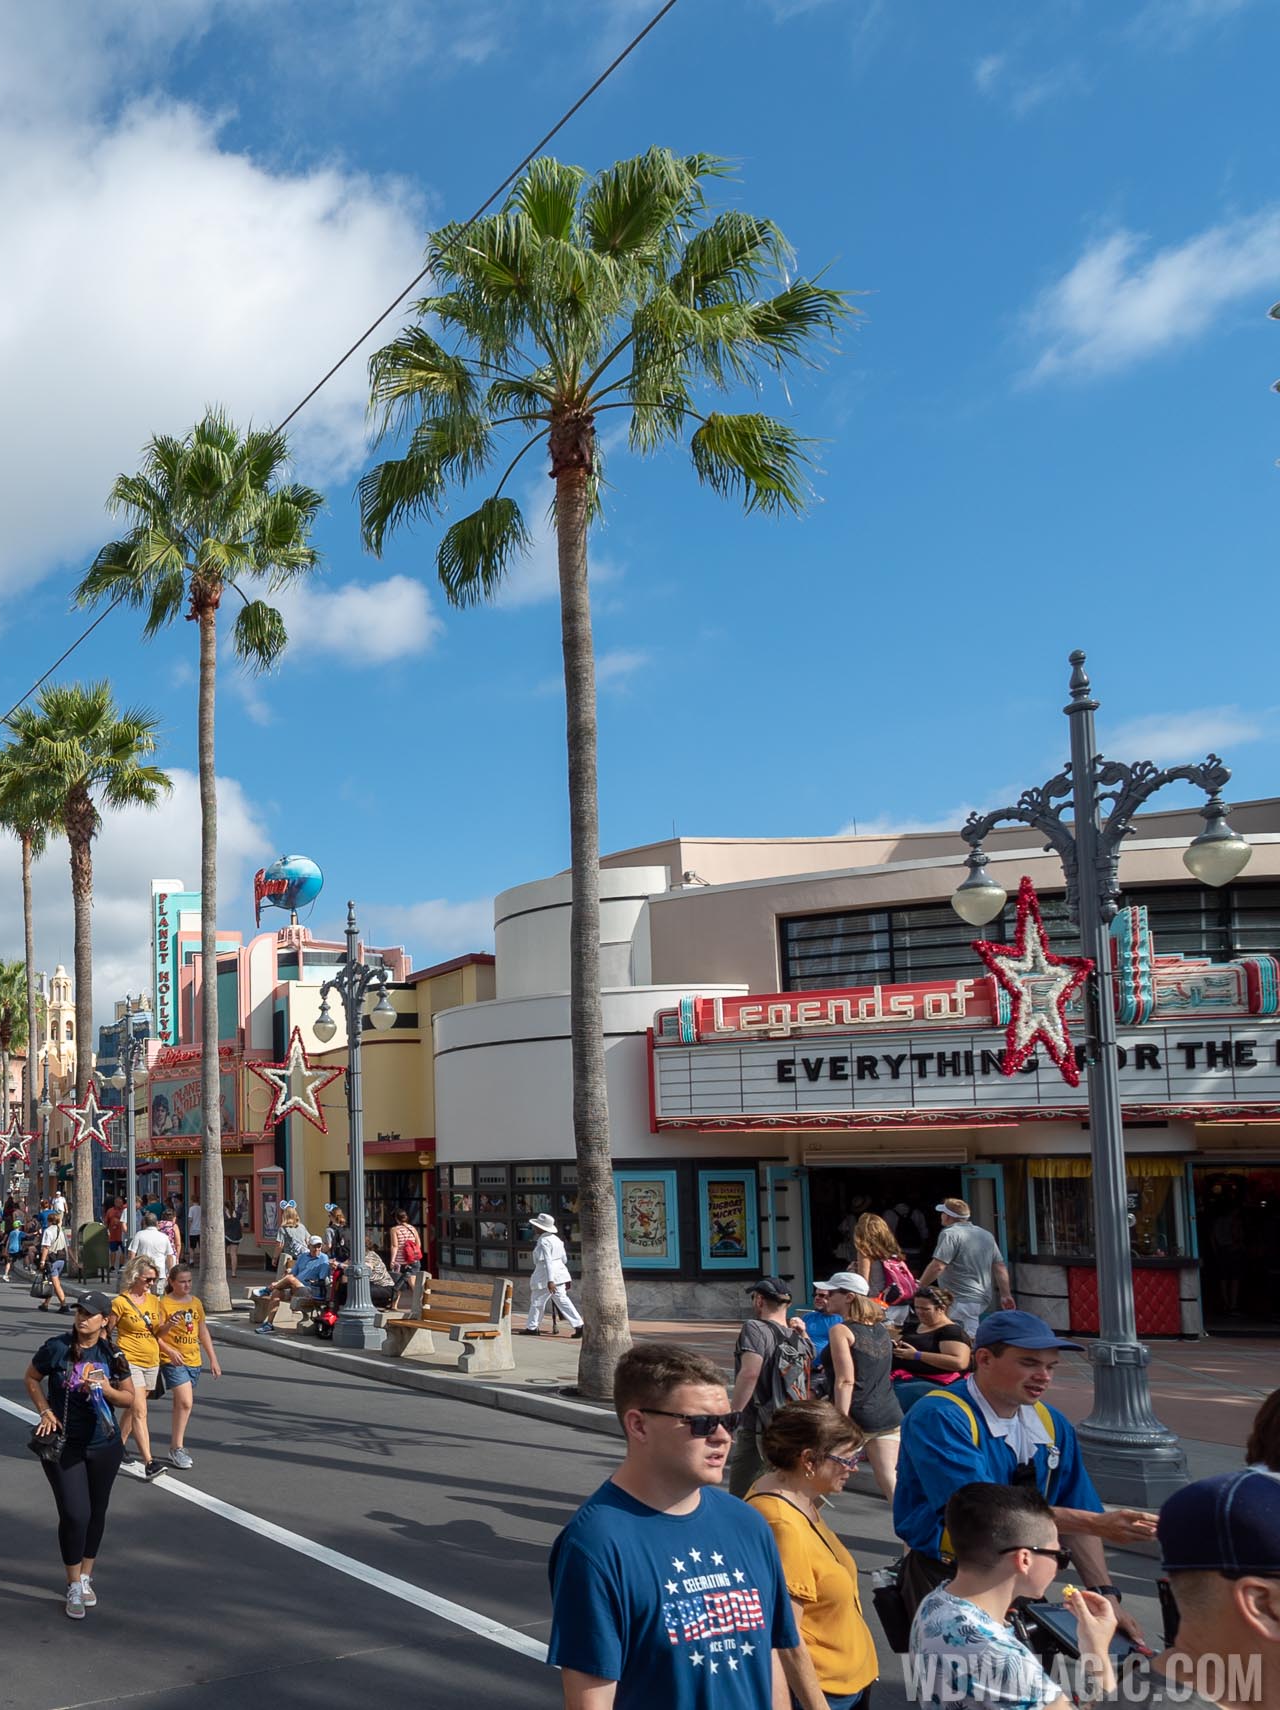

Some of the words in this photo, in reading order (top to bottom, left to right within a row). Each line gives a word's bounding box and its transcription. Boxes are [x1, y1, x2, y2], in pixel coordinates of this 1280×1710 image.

[158, 892, 169, 965] PLANET
[713, 985, 915, 1039] Legends
[923, 978, 975, 1020] of
[776, 1047, 1039, 1084] EVERYTHING
[1074, 1042, 1162, 1073] FR
[1176, 1039, 1258, 1070] THE
[712, 1207, 743, 1219] MICKEY
[174, 1335, 199, 1345] MOUS
[662, 1588, 764, 1645] FREEDOM
